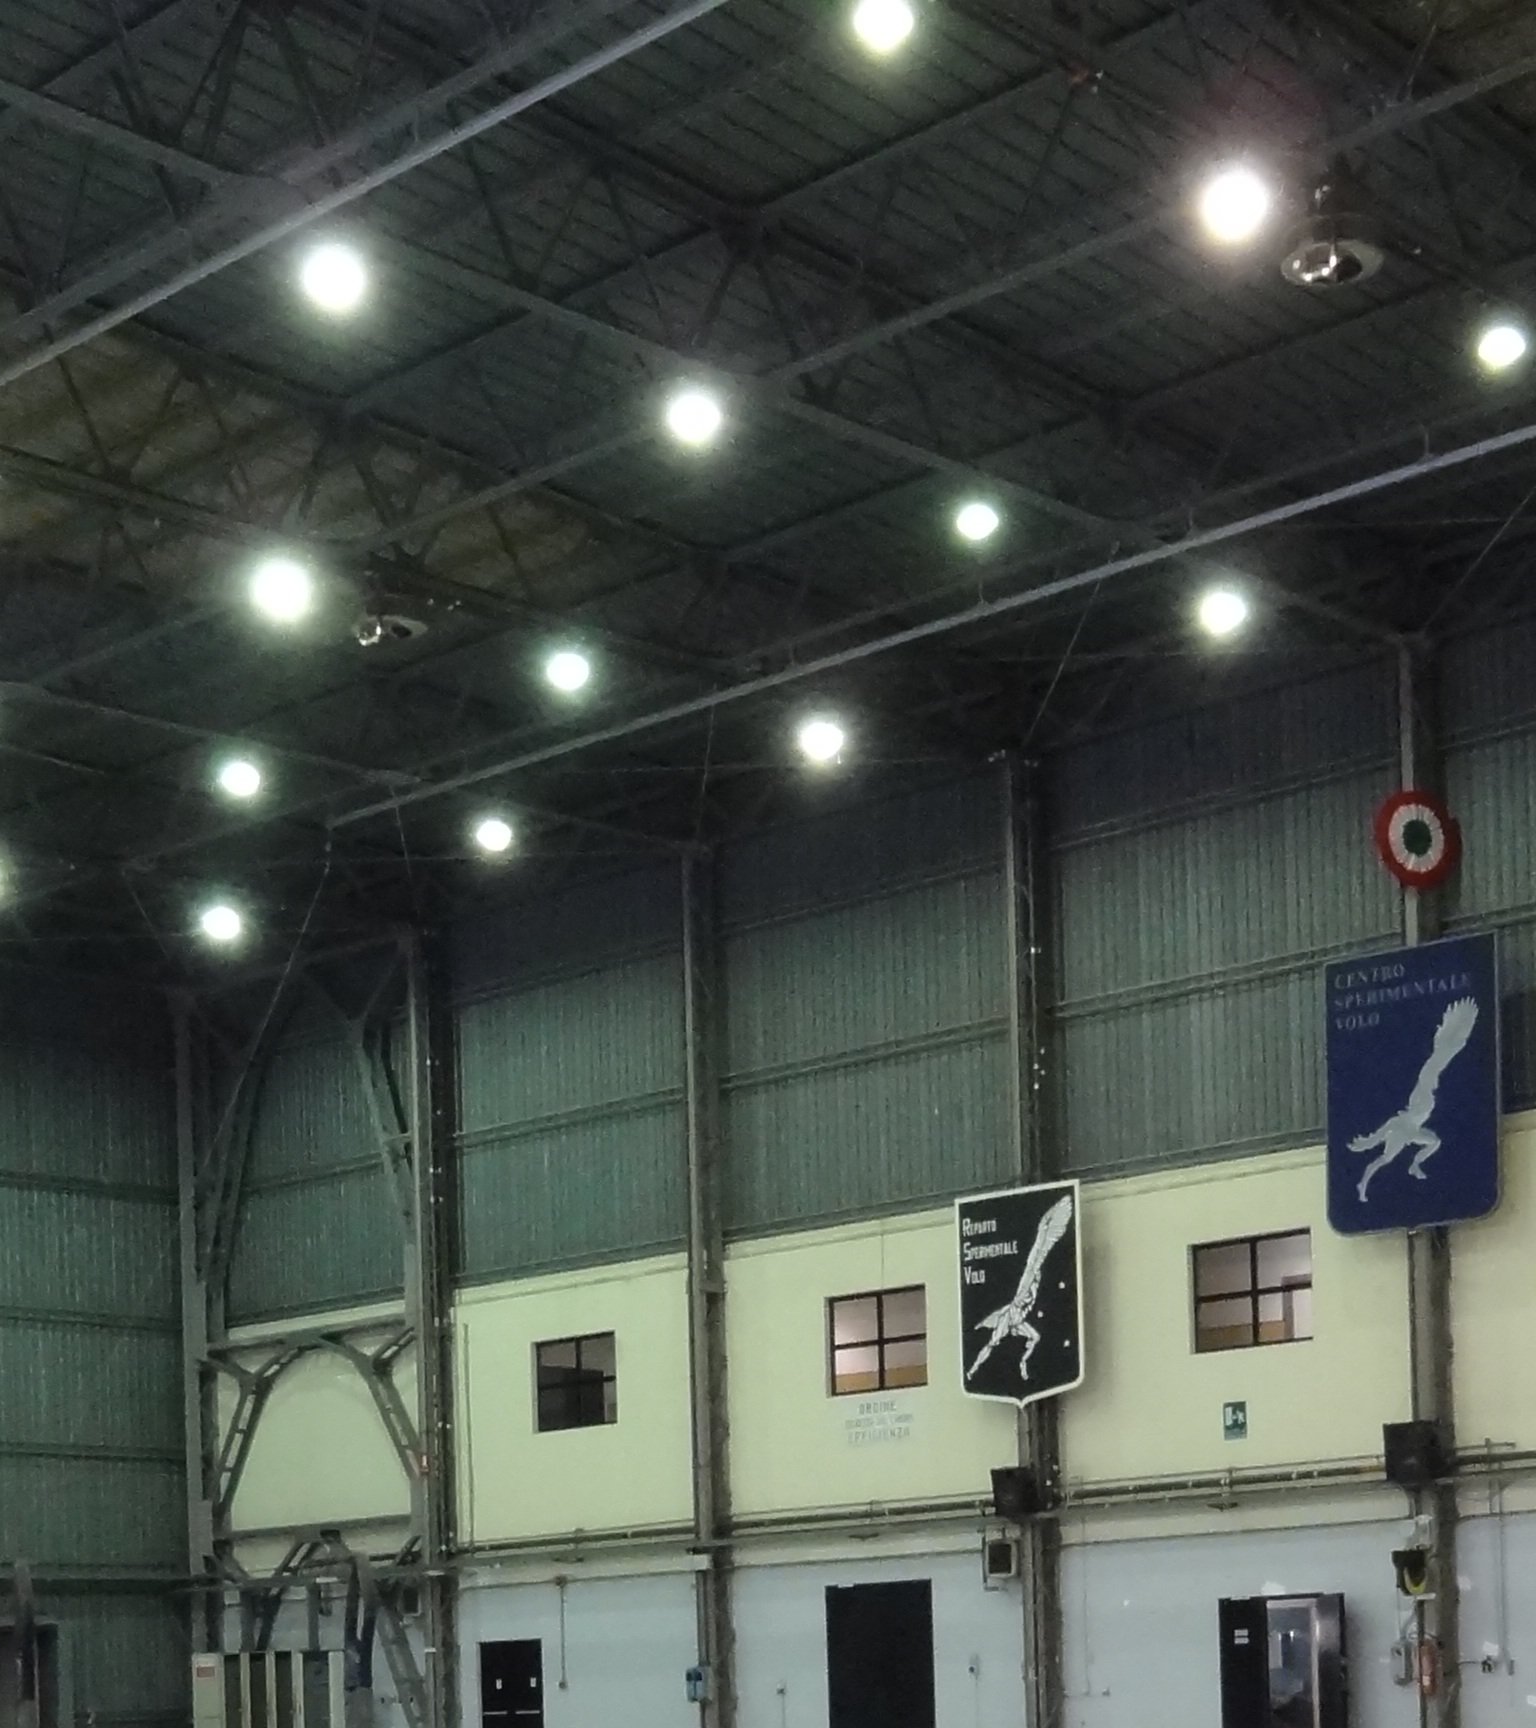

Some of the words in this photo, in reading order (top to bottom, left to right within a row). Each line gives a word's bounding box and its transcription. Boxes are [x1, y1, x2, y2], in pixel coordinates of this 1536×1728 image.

[1334, 963, 1405, 989] CENTRO
[1333, 972, 1472, 1010] SPERIMENTALE
[1336, 1012, 1381, 1031] VOLO
